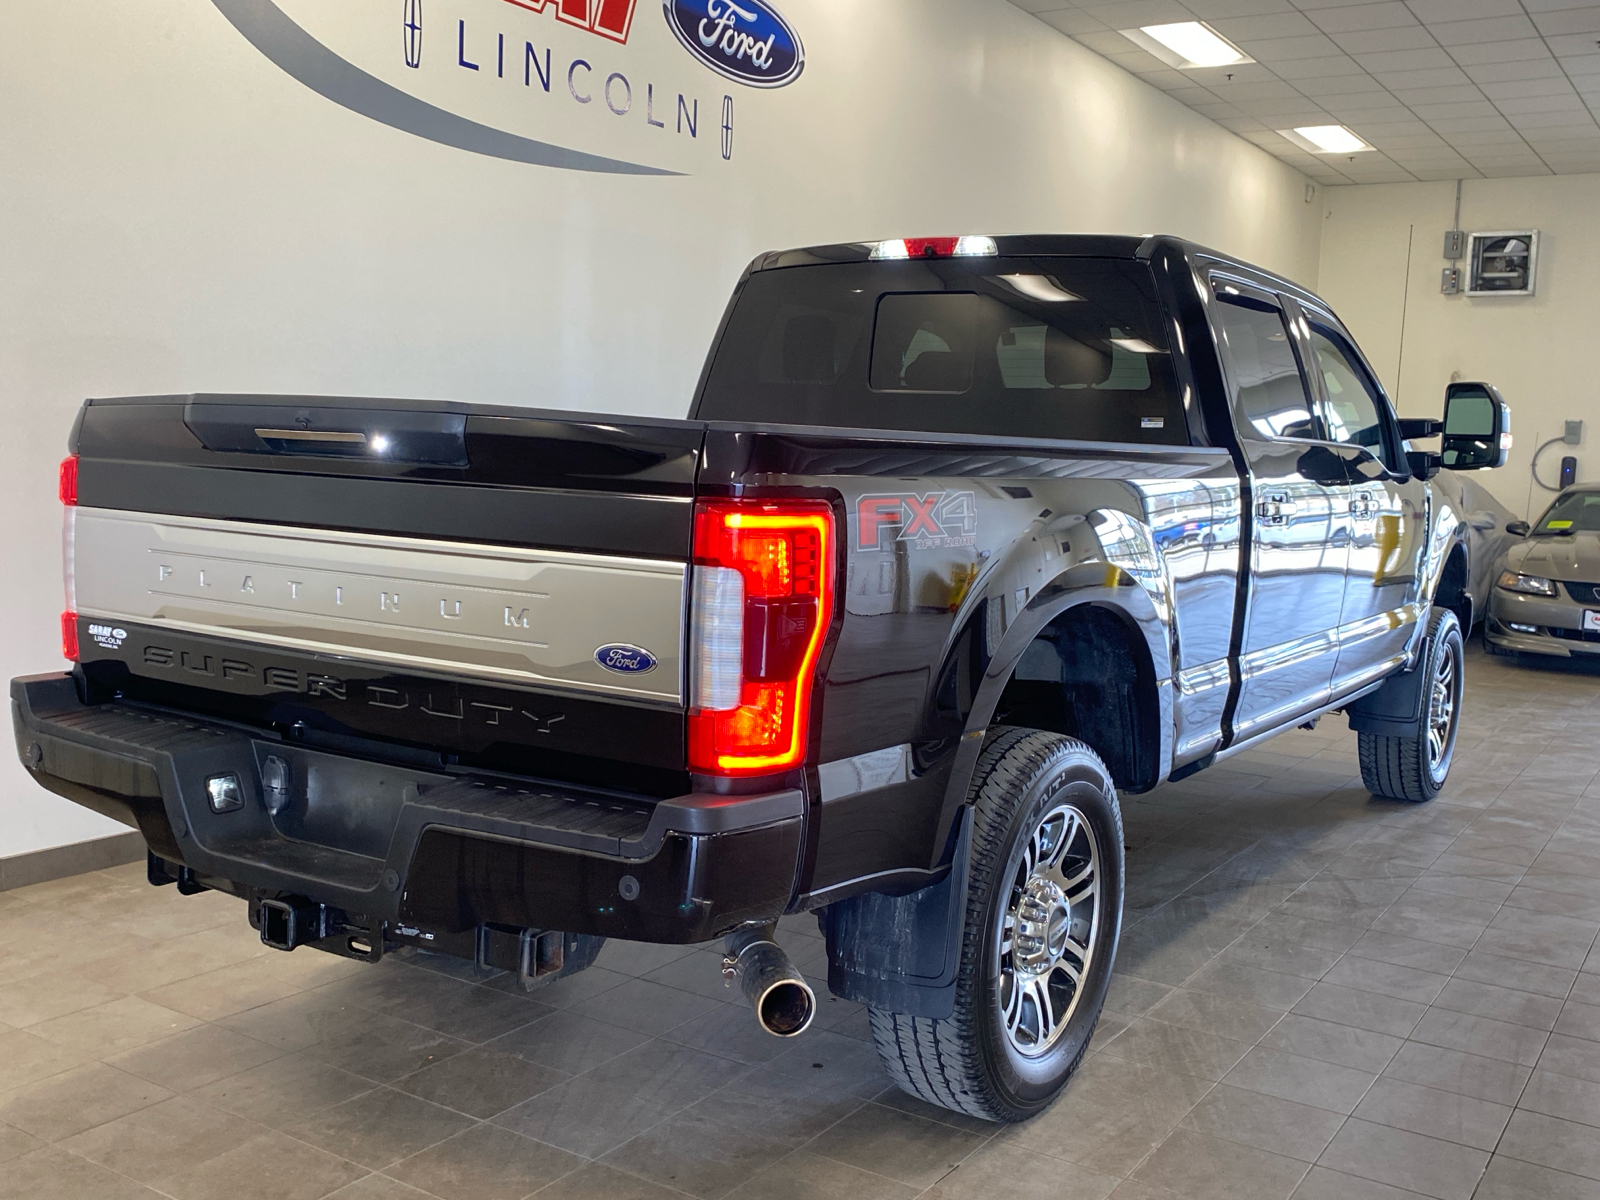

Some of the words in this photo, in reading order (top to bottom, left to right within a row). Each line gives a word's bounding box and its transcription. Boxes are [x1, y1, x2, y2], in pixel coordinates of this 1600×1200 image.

[698, 0, 775, 70] Ford
[459, 19, 698, 139] LINCOLN
[855, 491, 978, 552] FX4
[914, 539, 941, 551] OFF
[944, 535, 977, 549] ROAD
[159, 564, 530, 629] PLATINUM
[94, 634, 122, 646] LINCOLN
[606, 649, 641, 669] Ford
[143, 645, 346, 700] SUPER
[365, 680, 566, 734] DUTY
